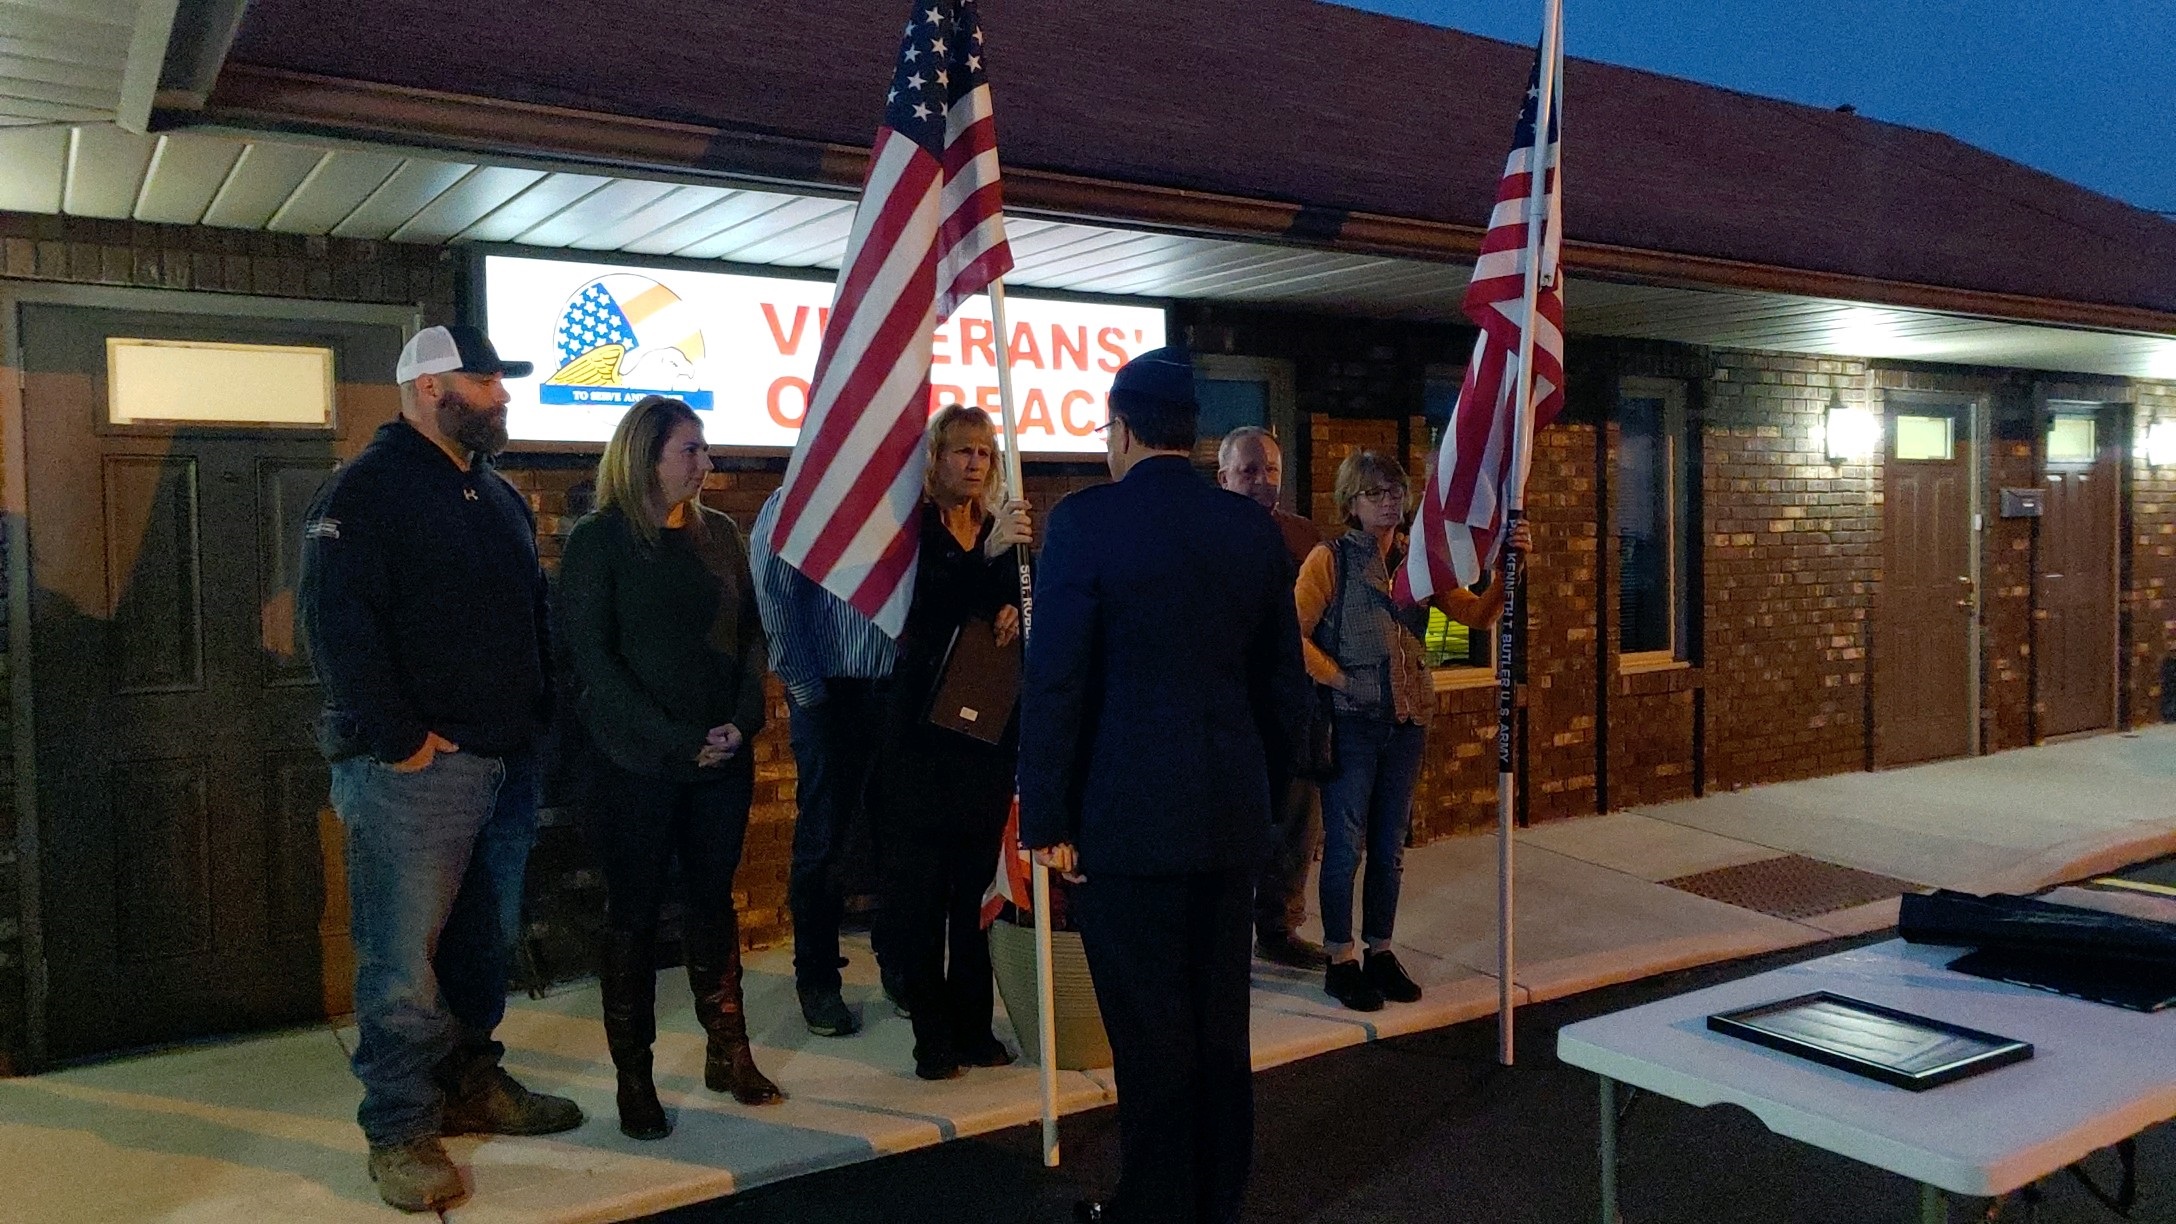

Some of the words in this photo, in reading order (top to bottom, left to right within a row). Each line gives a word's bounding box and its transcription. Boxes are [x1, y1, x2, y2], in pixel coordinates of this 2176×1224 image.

[572, 390, 589, 401] TO
[1504, 552, 1517, 617] KENNETH
[1500, 633, 1512, 688] BUTLER
[1499, 722, 1510, 763] ARMY
